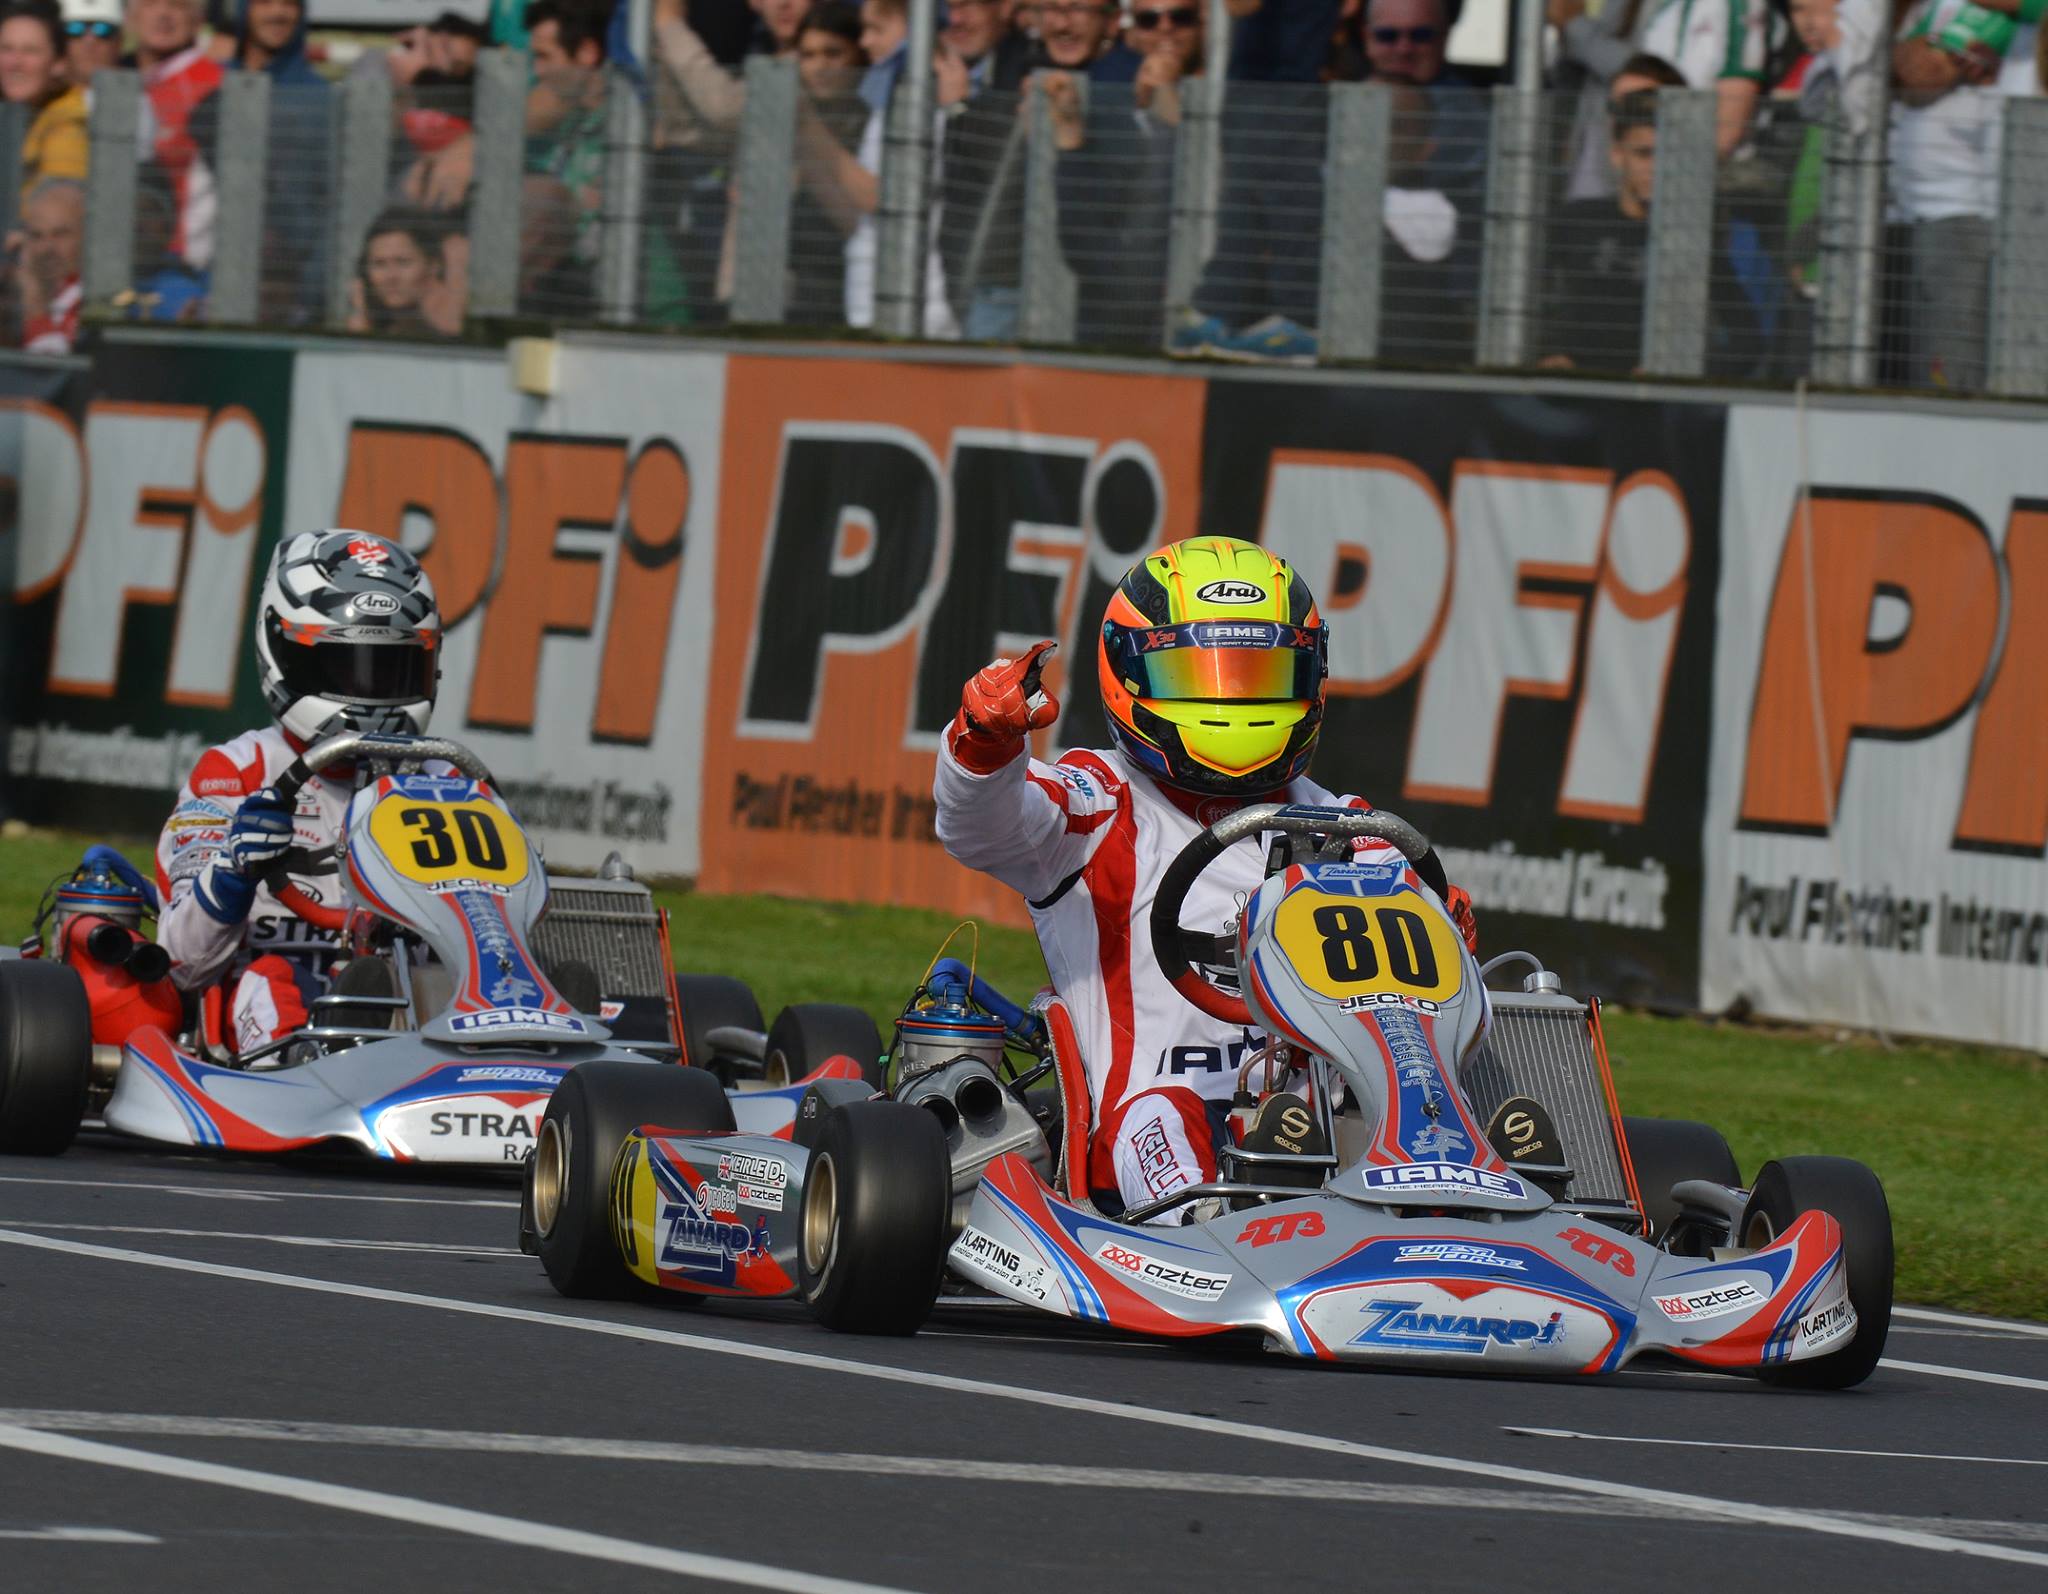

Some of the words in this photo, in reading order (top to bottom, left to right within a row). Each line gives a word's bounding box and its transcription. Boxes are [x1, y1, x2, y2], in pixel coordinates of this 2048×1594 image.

[336, 417, 691, 747] PFi
[735, 418, 1167, 758] PFi
[1203, 583, 1258, 600] Arai
[362, 595, 394, 608] Arai
[1144, 630, 1177, 650] X30
[1206, 628, 1266, 638] IAME
[1262, 446, 1692, 822] PFi
[401, 808, 507, 871] 30
[427, 878, 510, 893] JECKO
[1313, 905, 1439, 988] 80
[1340, 993, 1440, 1012] JECKO
[464, 1010, 572, 1029] IAME
[1274, 1135, 1302, 1153] sparco
[1512, 1141, 1544, 1158] sparco
[729, 1154, 767, 1178] KEIRLE
[768, 1161, 786, 1183] D.
[1381, 1166, 1510, 1192] IAME
[751, 1188, 782, 1202] aztec
[1236, 1211, 1326, 1248] 273
[961, 1229, 1020, 1272] KARTING
[1556, 1227, 1636, 1278] 273
[985, 1263, 1010, 1279] passion
[1144, 1263, 1228, 1291] aztec
[1688, 1284, 1756, 1309] aztec
[1801, 1302, 1846, 1338] KARTING
